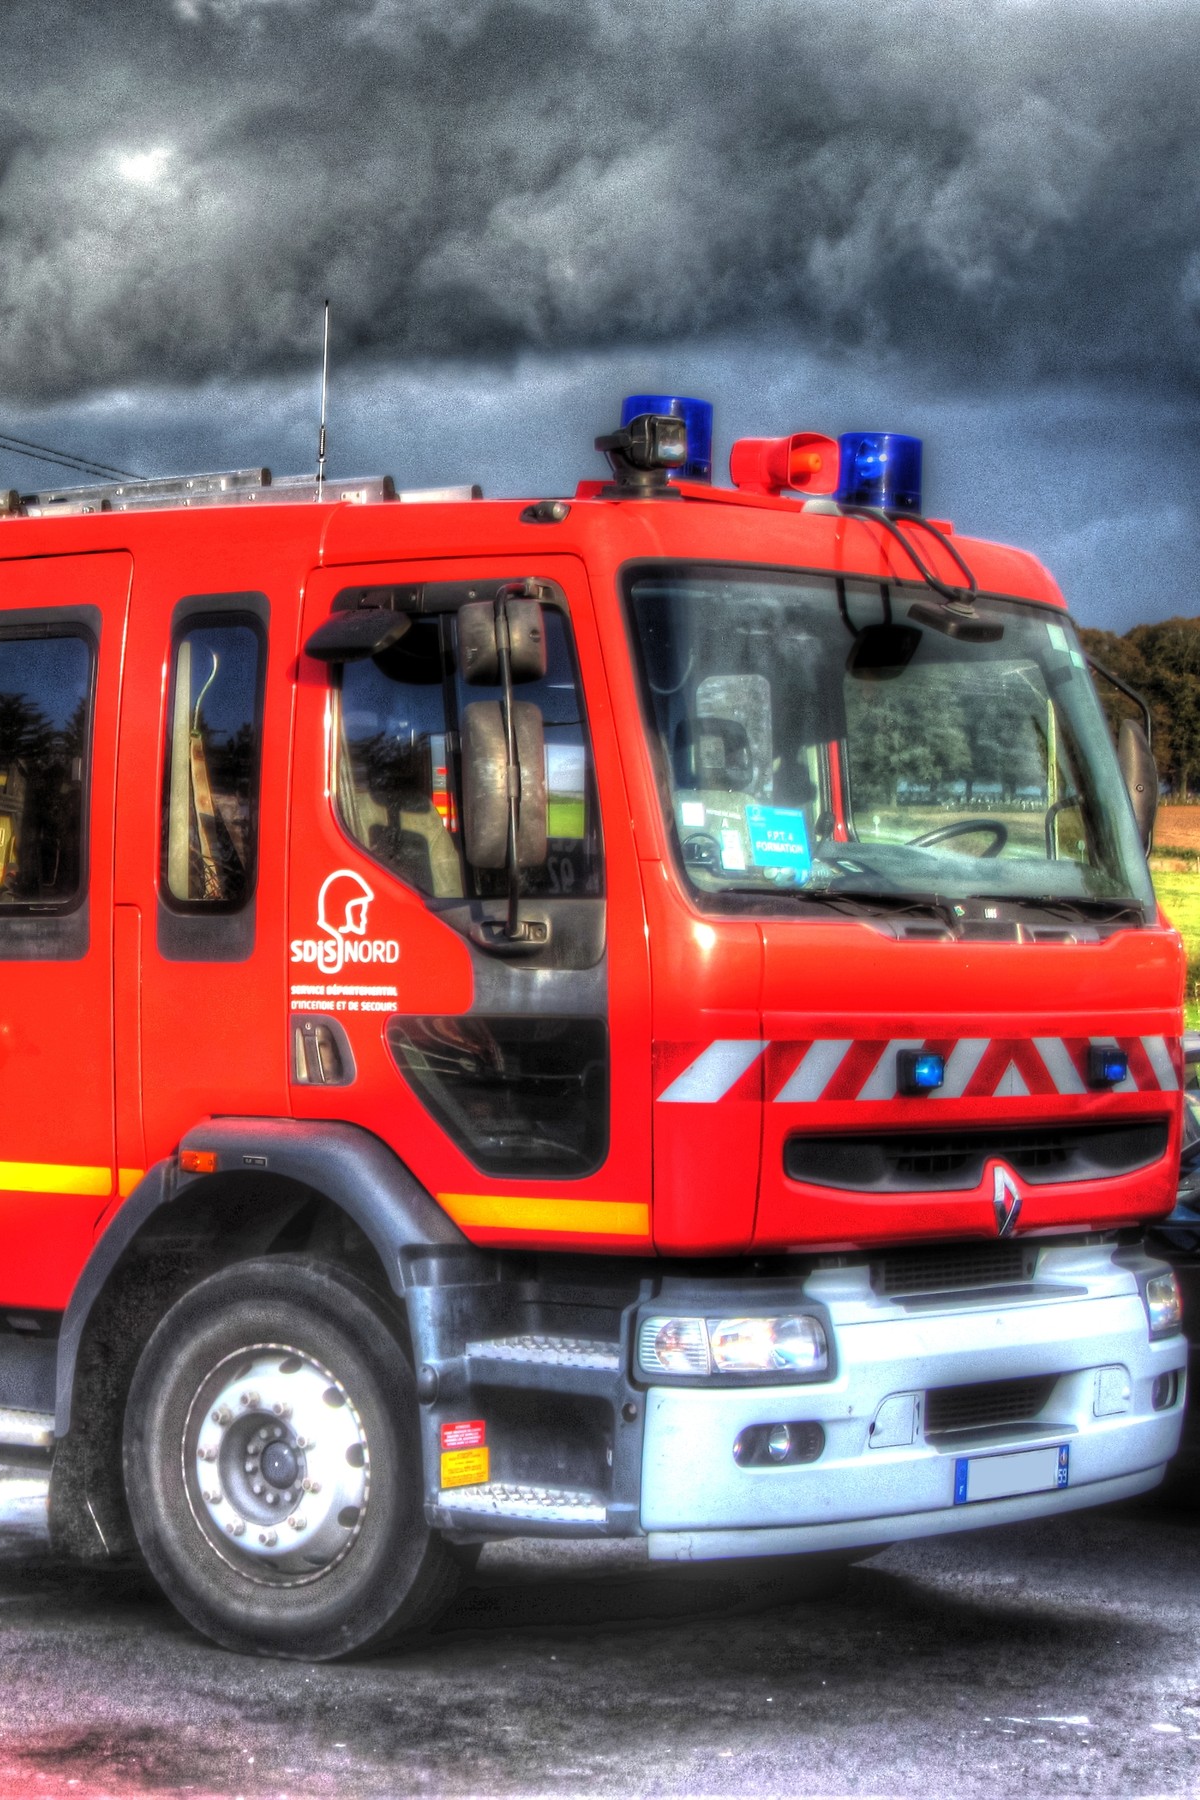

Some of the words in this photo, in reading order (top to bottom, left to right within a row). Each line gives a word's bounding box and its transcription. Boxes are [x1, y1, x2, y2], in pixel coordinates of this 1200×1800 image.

[756, 841, 804, 855] FORMATION
[344, 940, 400, 963] NORD
[336, 1001, 347, 1011] ET
[348, 1001, 360, 1011] DE
[361, 1001, 398, 1012] SECOURS
[1058, 1468, 1067, 1483] 59
